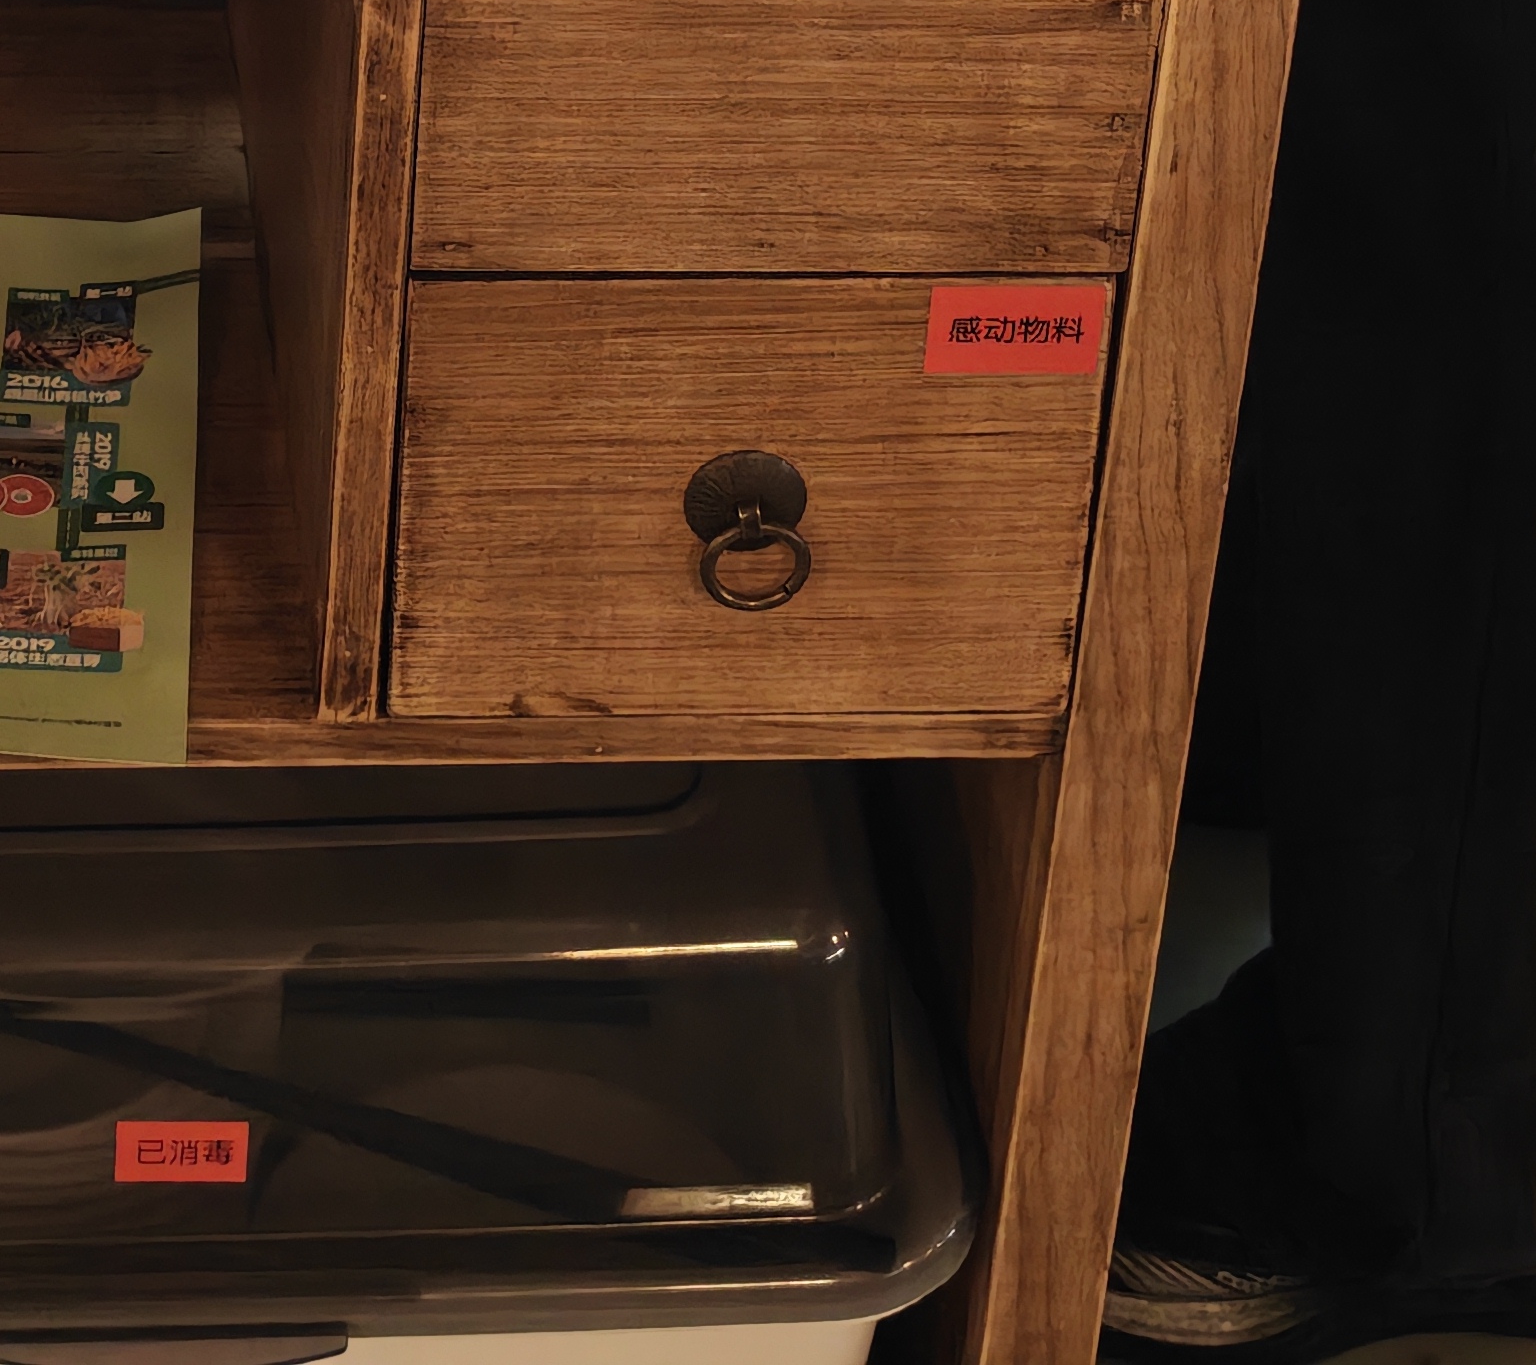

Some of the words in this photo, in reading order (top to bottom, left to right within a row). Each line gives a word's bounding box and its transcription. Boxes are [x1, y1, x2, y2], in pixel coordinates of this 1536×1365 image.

[947, 312, 1085, 345] 感动物料
[6, 373, 69, 389] 2016
[93, 431, 113, 471] 2019
